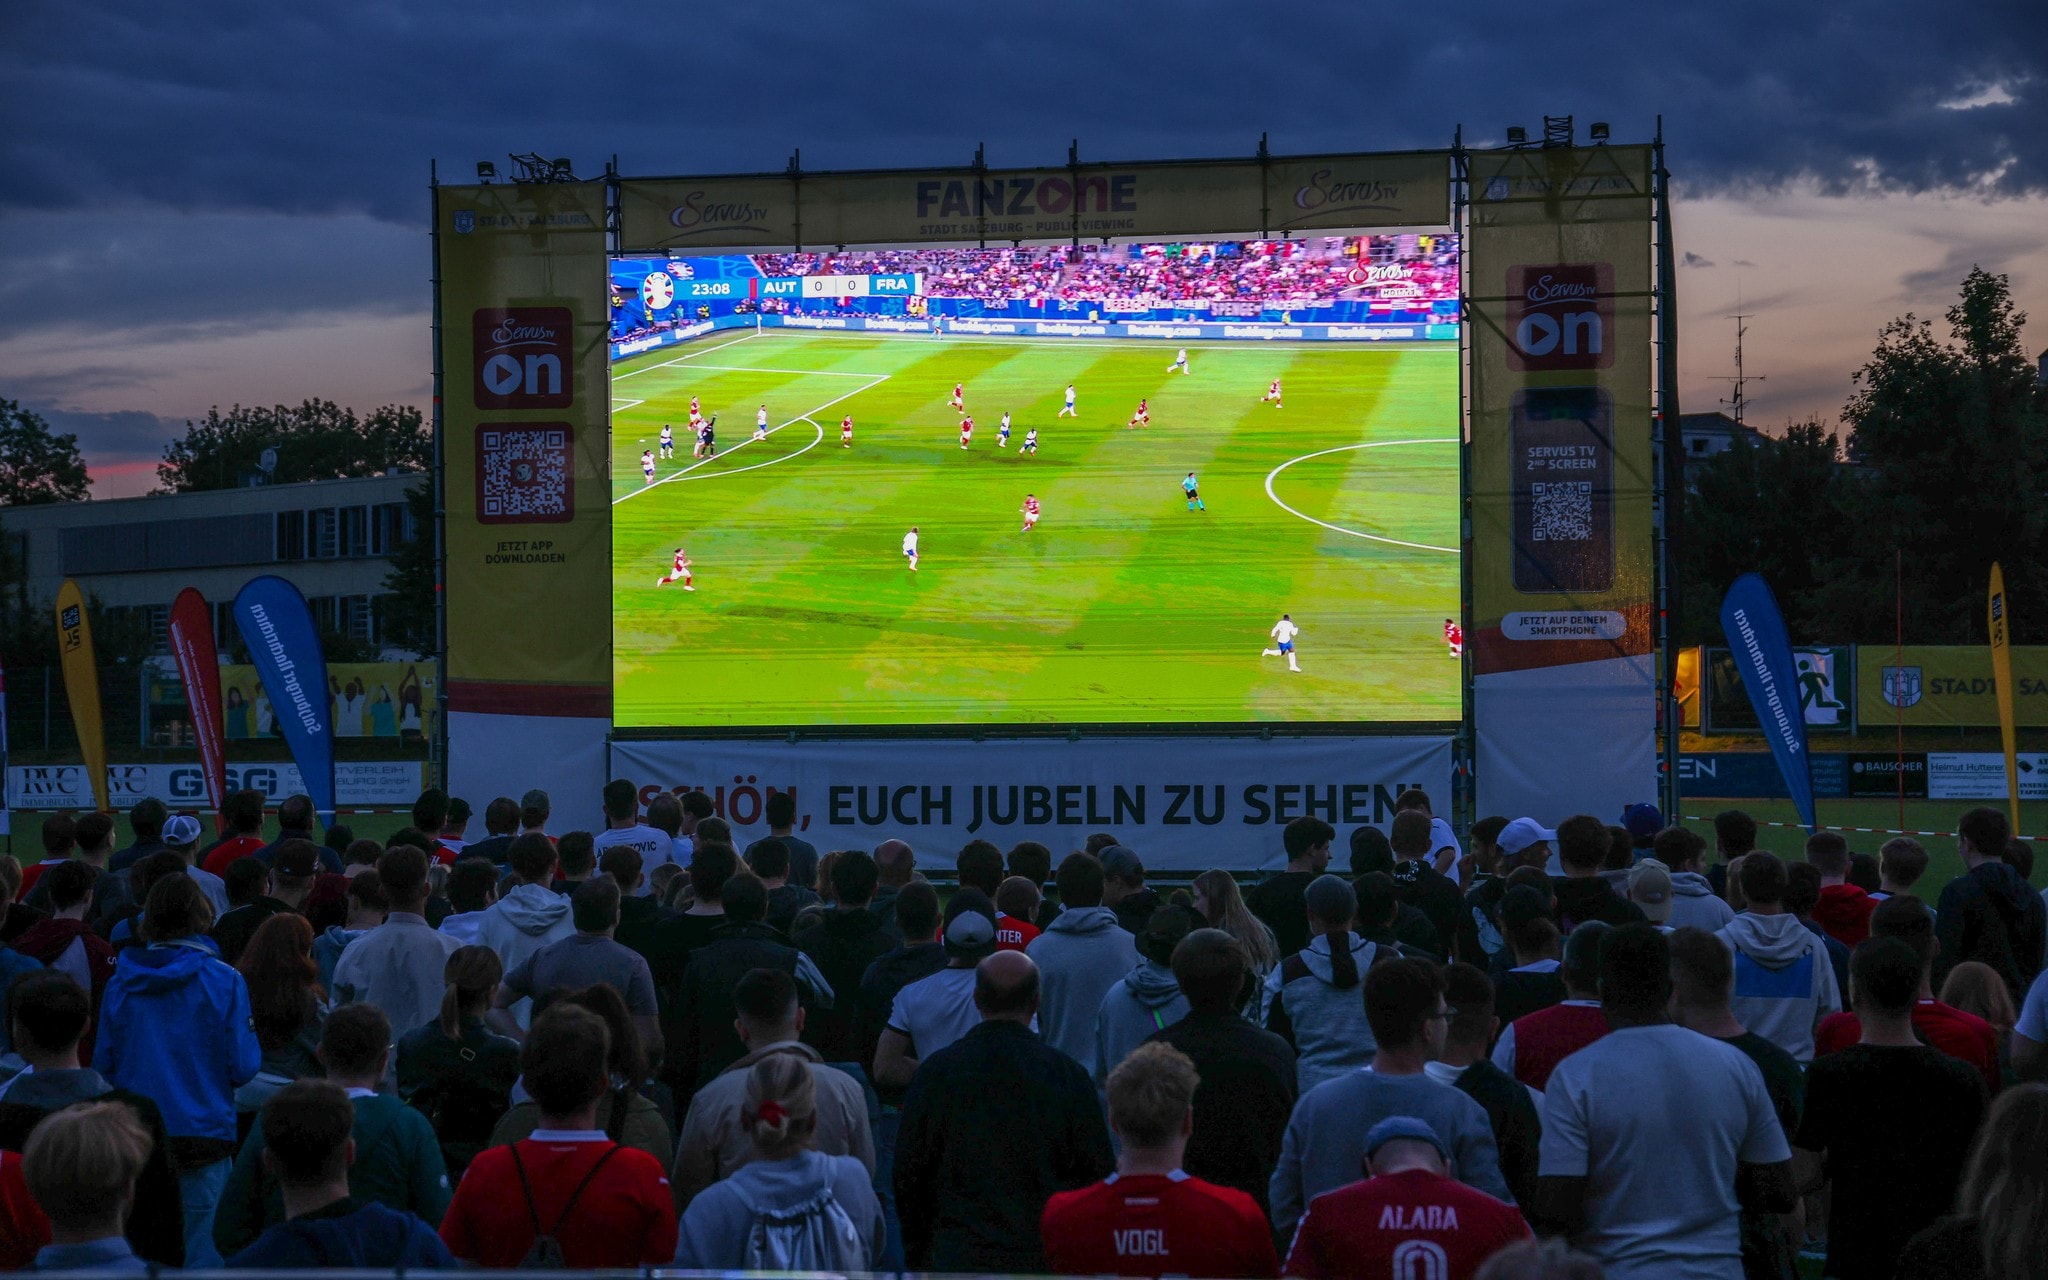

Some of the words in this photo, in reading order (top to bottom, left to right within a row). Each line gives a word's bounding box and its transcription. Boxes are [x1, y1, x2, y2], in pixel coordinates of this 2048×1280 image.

[480, 216, 516, 226] STADT
[920, 224, 957, 235] STADT
[961, 222, 1023, 234] SALZBURG
[1036, 221, 1078, 232] PUBLIC
[1082, 218, 1135, 231] VIEWING
[691, 283, 731, 295] 23:08
[763, 281, 797, 294] AUT
[814, 281, 823, 291] 0
[847, 280, 856, 290] 0
[876, 277, 908, 290] FRA
[1528, 446, 1576, 458] SERVUS
[1579, 445, 1596, 456] TV
[1548, 458, 1597, 470] SCREEN
[496, 541, 528, 553] JETZT
[531, 540, 553, 551] APP
[486, 553, 565, 565] DOWNLOADEN
[1519, 616, 1547, 627] JETZT
[1549, 616, 1568, 625] AUF
[1570, 615, 1607, 625] DEINEM
[1530, 626, 1596, 635] SMARTPHONE
[1866, 761, 1923, 771] BAUSCHER
[1930, 763, 1963, 771] Helmut
[1966, 763, 2004, 771] Hutterer
[22, 766, 79, 794] RVC
[21, 797, 79, 806] IMMOBILIEN
[829, 784, 952, 825] EUCH
[966, 784, 1146, 834] JUBELN
[1162, 784, 1225, 826] ZU
[1378, 1204, 1459, 1231] ALABA
[1113, 1229, 1170, 1256] VOGL
